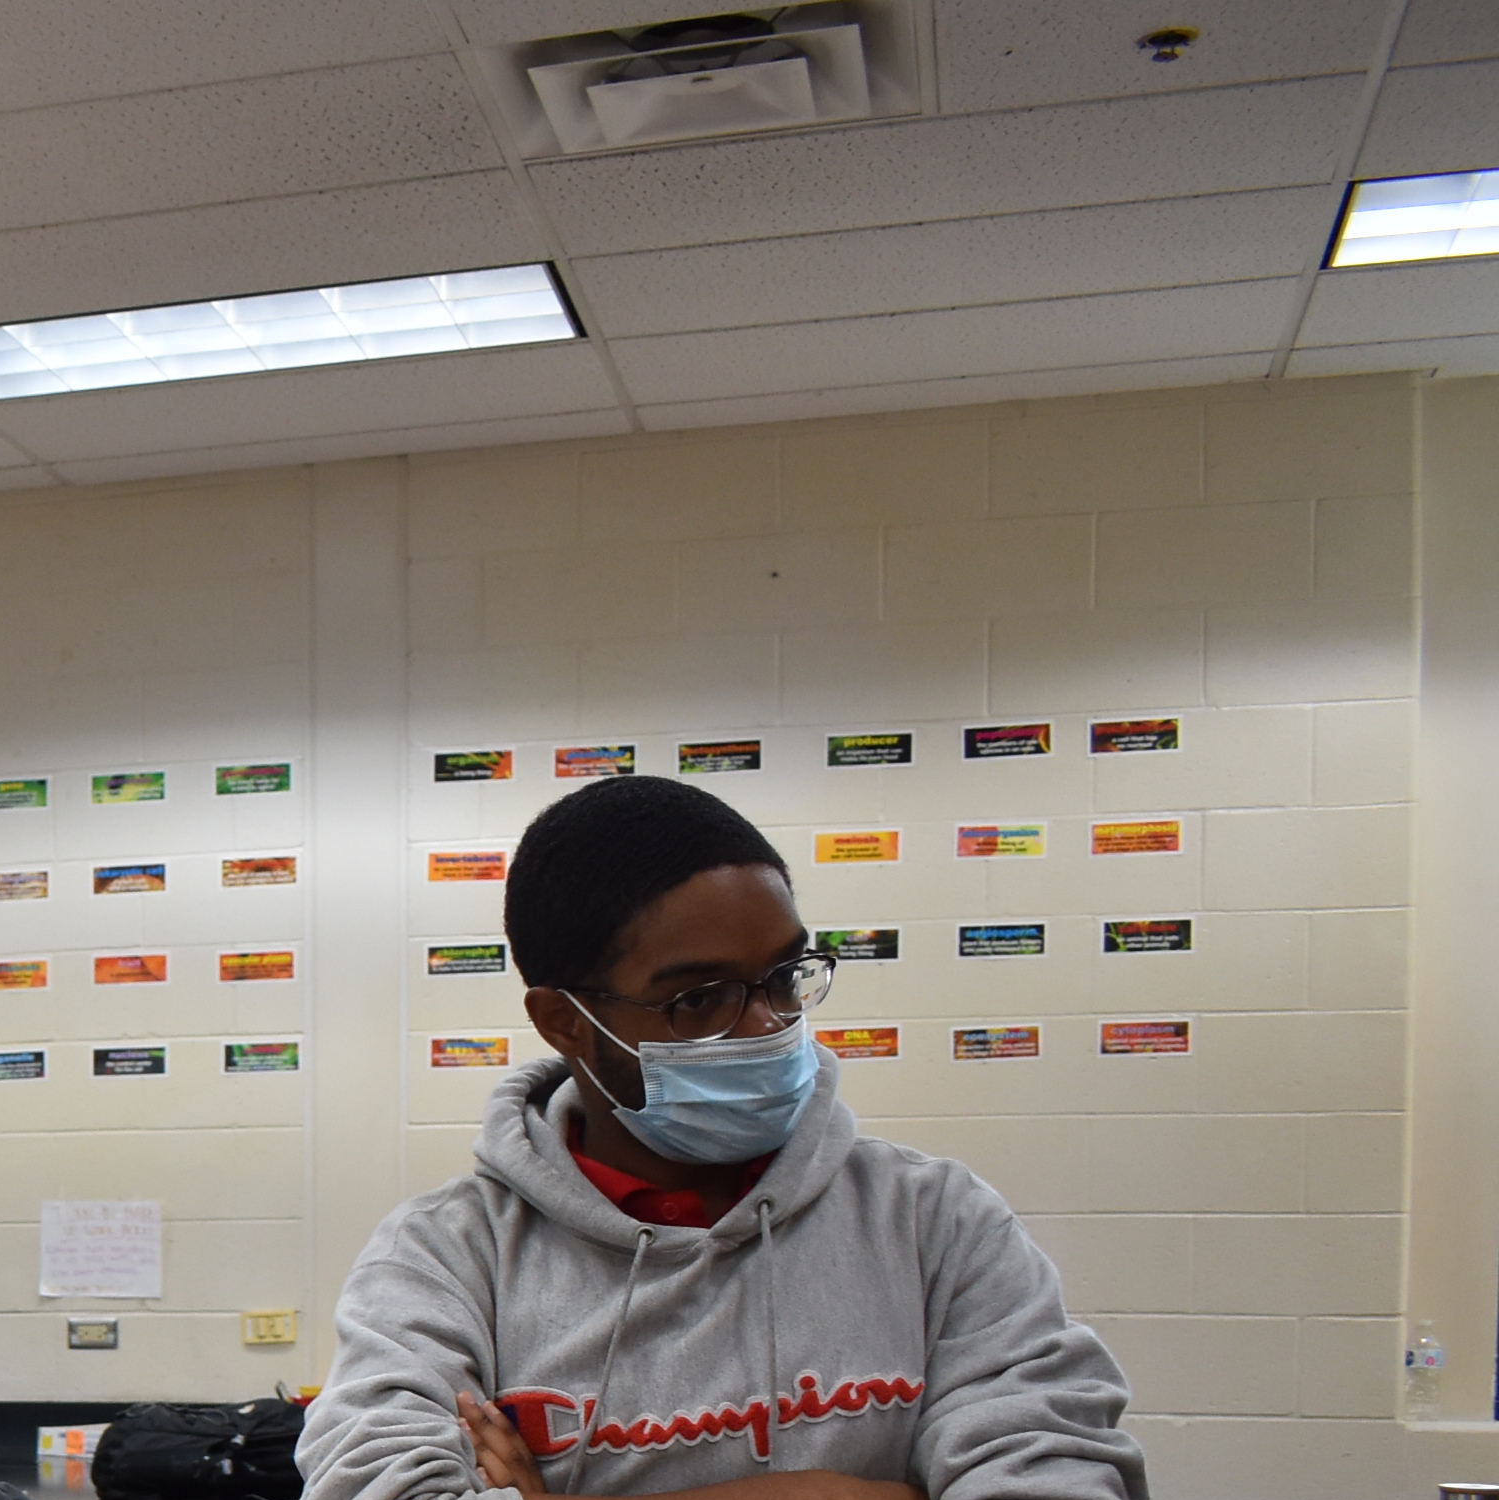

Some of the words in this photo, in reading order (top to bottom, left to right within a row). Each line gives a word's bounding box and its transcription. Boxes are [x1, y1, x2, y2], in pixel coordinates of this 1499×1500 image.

[843, 737, 899, 748] producer
[1094, 824, 1179, 835] metamorphosis
[844, 1030, 870, 1041] DNA
[1111, 1026, 1174, 1037] cytoplasm
[497, 1371, 926, 1462] Champion
